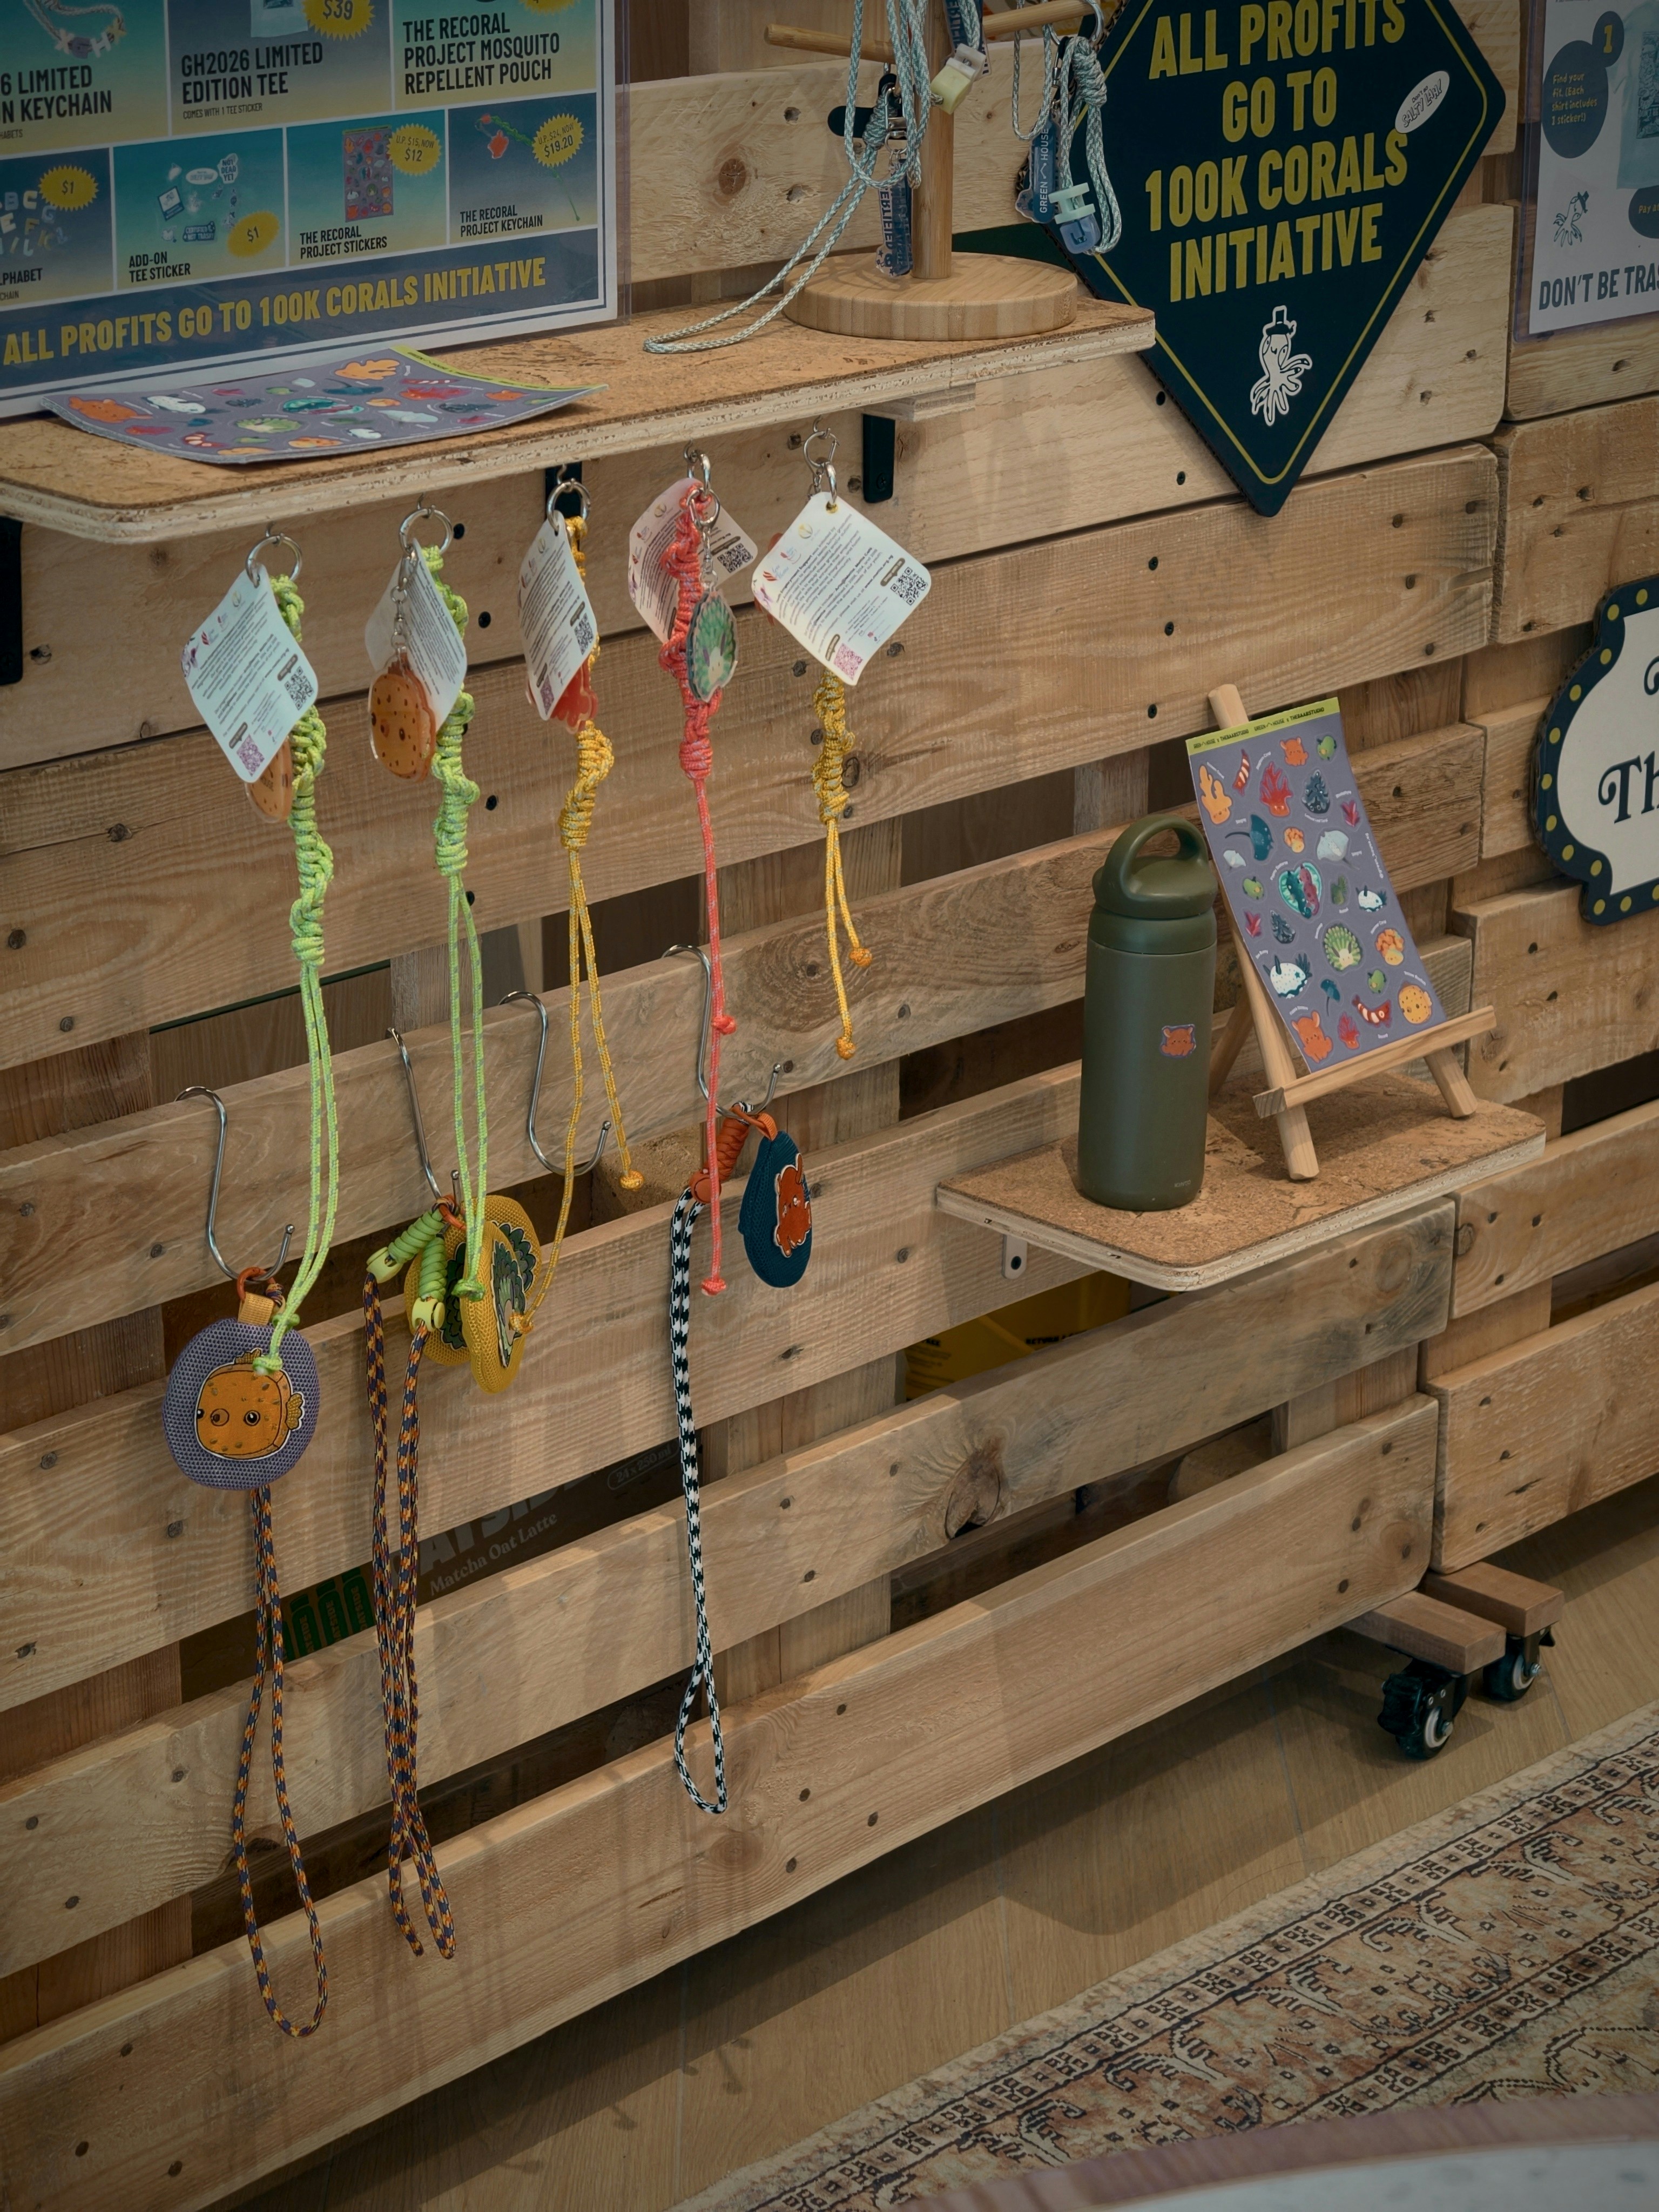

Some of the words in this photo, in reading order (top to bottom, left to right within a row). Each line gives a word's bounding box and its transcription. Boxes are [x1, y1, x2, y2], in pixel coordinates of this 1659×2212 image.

[323, 0, 353, 21] $39
[402, 19, 435, 43] THE
[439, 12, 510, 39] RECORAL
[1603, 24, 1613, 53] 1
[404, 39, 475, 69] PROJECT
[480, 32, 560, 59] MOSQUITO
[1149, 9, 1229, 80] ALL
[1239, 0, 1406, 65] PROFITS
[181, 49, 250, 78] GH2026
[255, 42, 323, 70] LIMITED
[18, 65, 92, 95] LIMITED
[182, 76, 253, 105] EDITION
[257, 71, 289, 96] TEE
[405, 65, 495, 95] REPELLENT
[500, 58, 551, 85] POUCH
[1553, 73, 1567, 85] Find
[1569, 72, 1585, 84] your
[1566, 86, 1584, 97] (Each
[0, 100, 14, 124] N
[21, 90, 112, 122] KEYCHAIN
[183, 108, 203, 120] COMES
[204, 106, 220, 118] WITH
[226, 105, 238, 115] TEE
[238, 103, 262, 114] STICKER
[1222, 76, 1276, 143] GO
[1286, 66, 1338, 131] TO
[1402, 97, 1424, 127] SALTY
[1552, 101, 1568, 112] shirt
[1569, 98, 1598, 109] includes
[562, 123, 575, 134] NOW
[1557, 112, 1587, 125] sticker!)
[404, 149, 423, 162] $12
[408, 138, 421, 147] $15,
[422, 139, 435, 149] NOW
[543, 135, 574, 158] $19.20
[1041, 128, 1049, 160] HOUSE
[221, 166, 236, 174] DEAD
[1145, 154, 1248, 232] 100K
[1258, 131, 1408, 210] CORALS
[62, 180, 75, 195] $1
[1040, 181, 1048, 213] GREEN
[460, 210, 478, 224] THE
[479, 205, 517, 221] RECORAL
[1638, 205, 1652, 215] Pay
[247, 226, 259, 243] $1
[300, 231, 319, 245] THE
[321, 225, 362, 242] RECORAL
[460, 221, 498, 238] PROJECT
[501, 214, 543, 232] KEYCHAIN
[300, 241, 341, 259] PROJECT
[344, 236, 388, 253] STICKERS
[1170, 203, 1383, 302] INITIATIVE
[129, 252, 167, 268] ADD-ON
[130, 268, 149, 282] TEE
[150, 263, 191, 280] STICKER
[1539, 273, 1593, 310] DON'T
[1597, 268, 1620, 300] BE
[3, 328, 54, 366] ALL
[61, 311, 172, 357] PROFITS
[178, 305, 212, 339] GO
[218, 299, 252, 333] TO
[259, 288, 320, 327] 100K
[326, 274, 418, 317] CORALS
[424, 257, 546, 303] INITIATIVE
[429, 1556, 487, 1596] Matcha
[488, 1537, 518, 1560] Oat
[517, 1513, 558, 1545] Latte
[326, 1600, 342, 1641] ATSIDE
